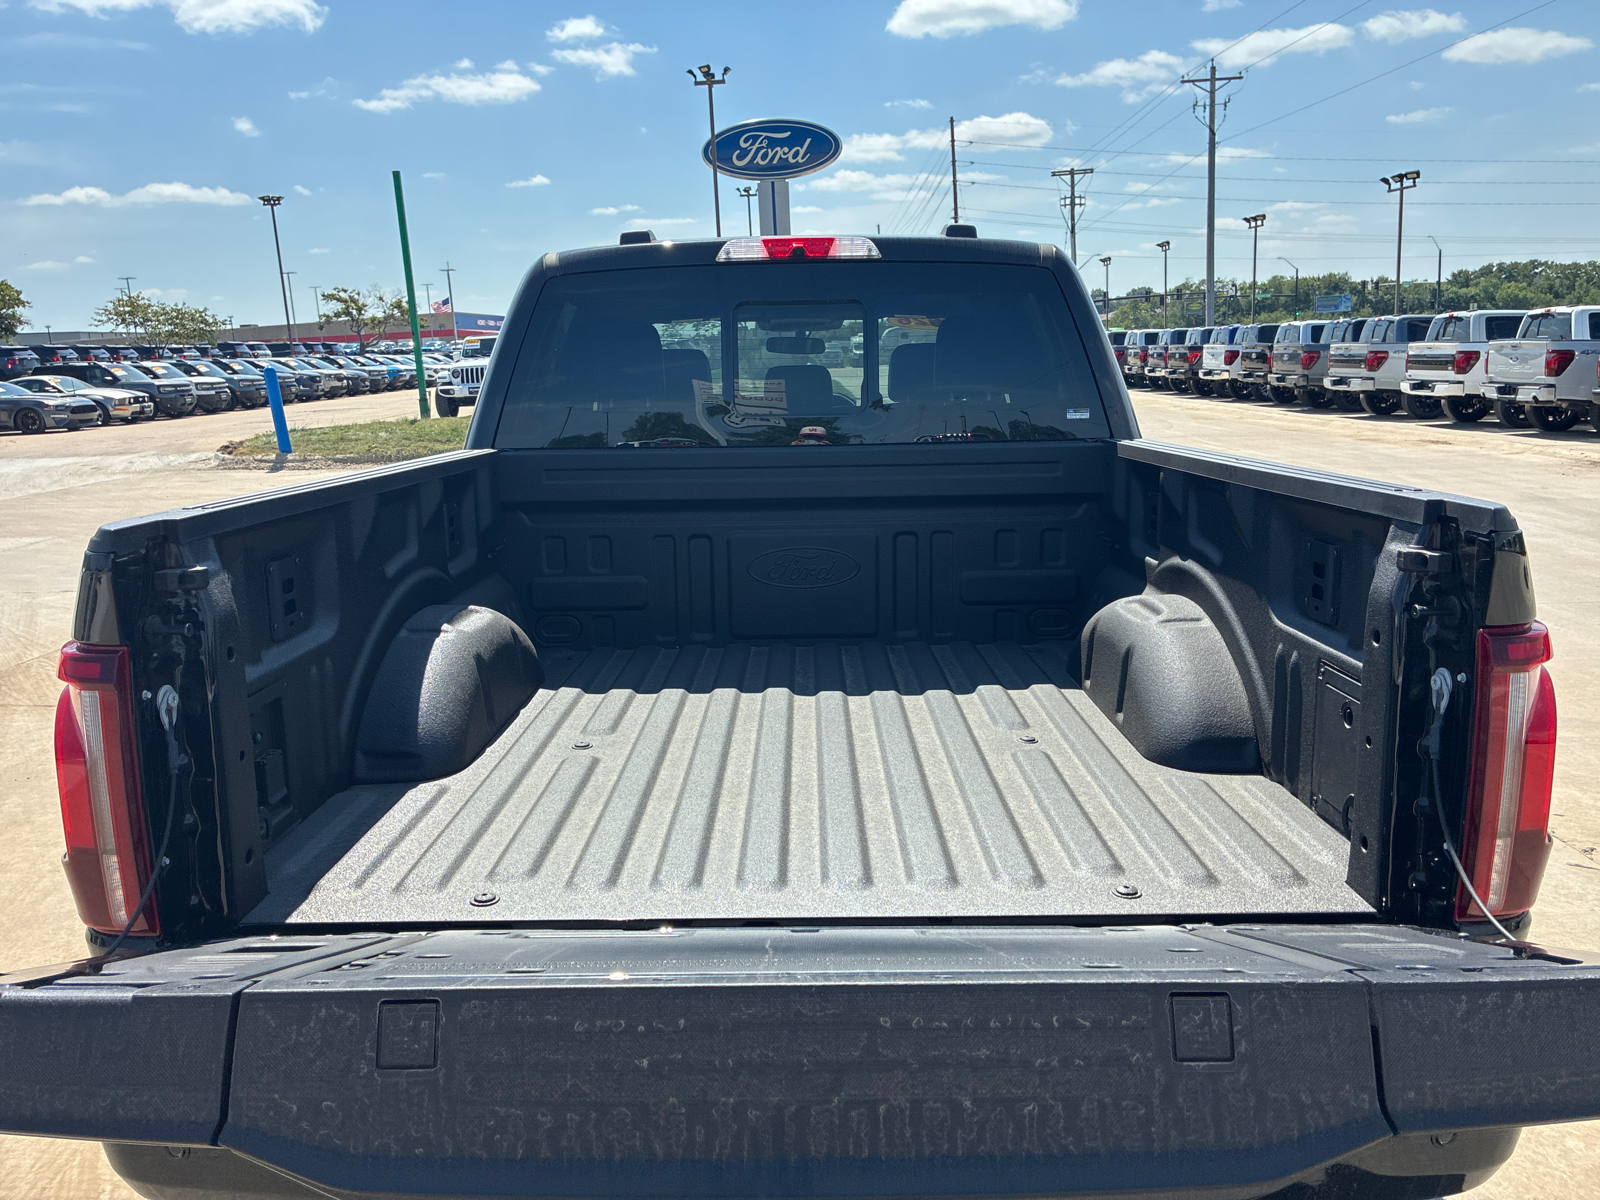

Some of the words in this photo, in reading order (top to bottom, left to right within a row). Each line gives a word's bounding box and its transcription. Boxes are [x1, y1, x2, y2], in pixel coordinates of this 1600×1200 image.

[732, 131, 812, 167] Ford
[1496, 365, 1534, 373] F-150
[768, 553, 837, 581] Ford
